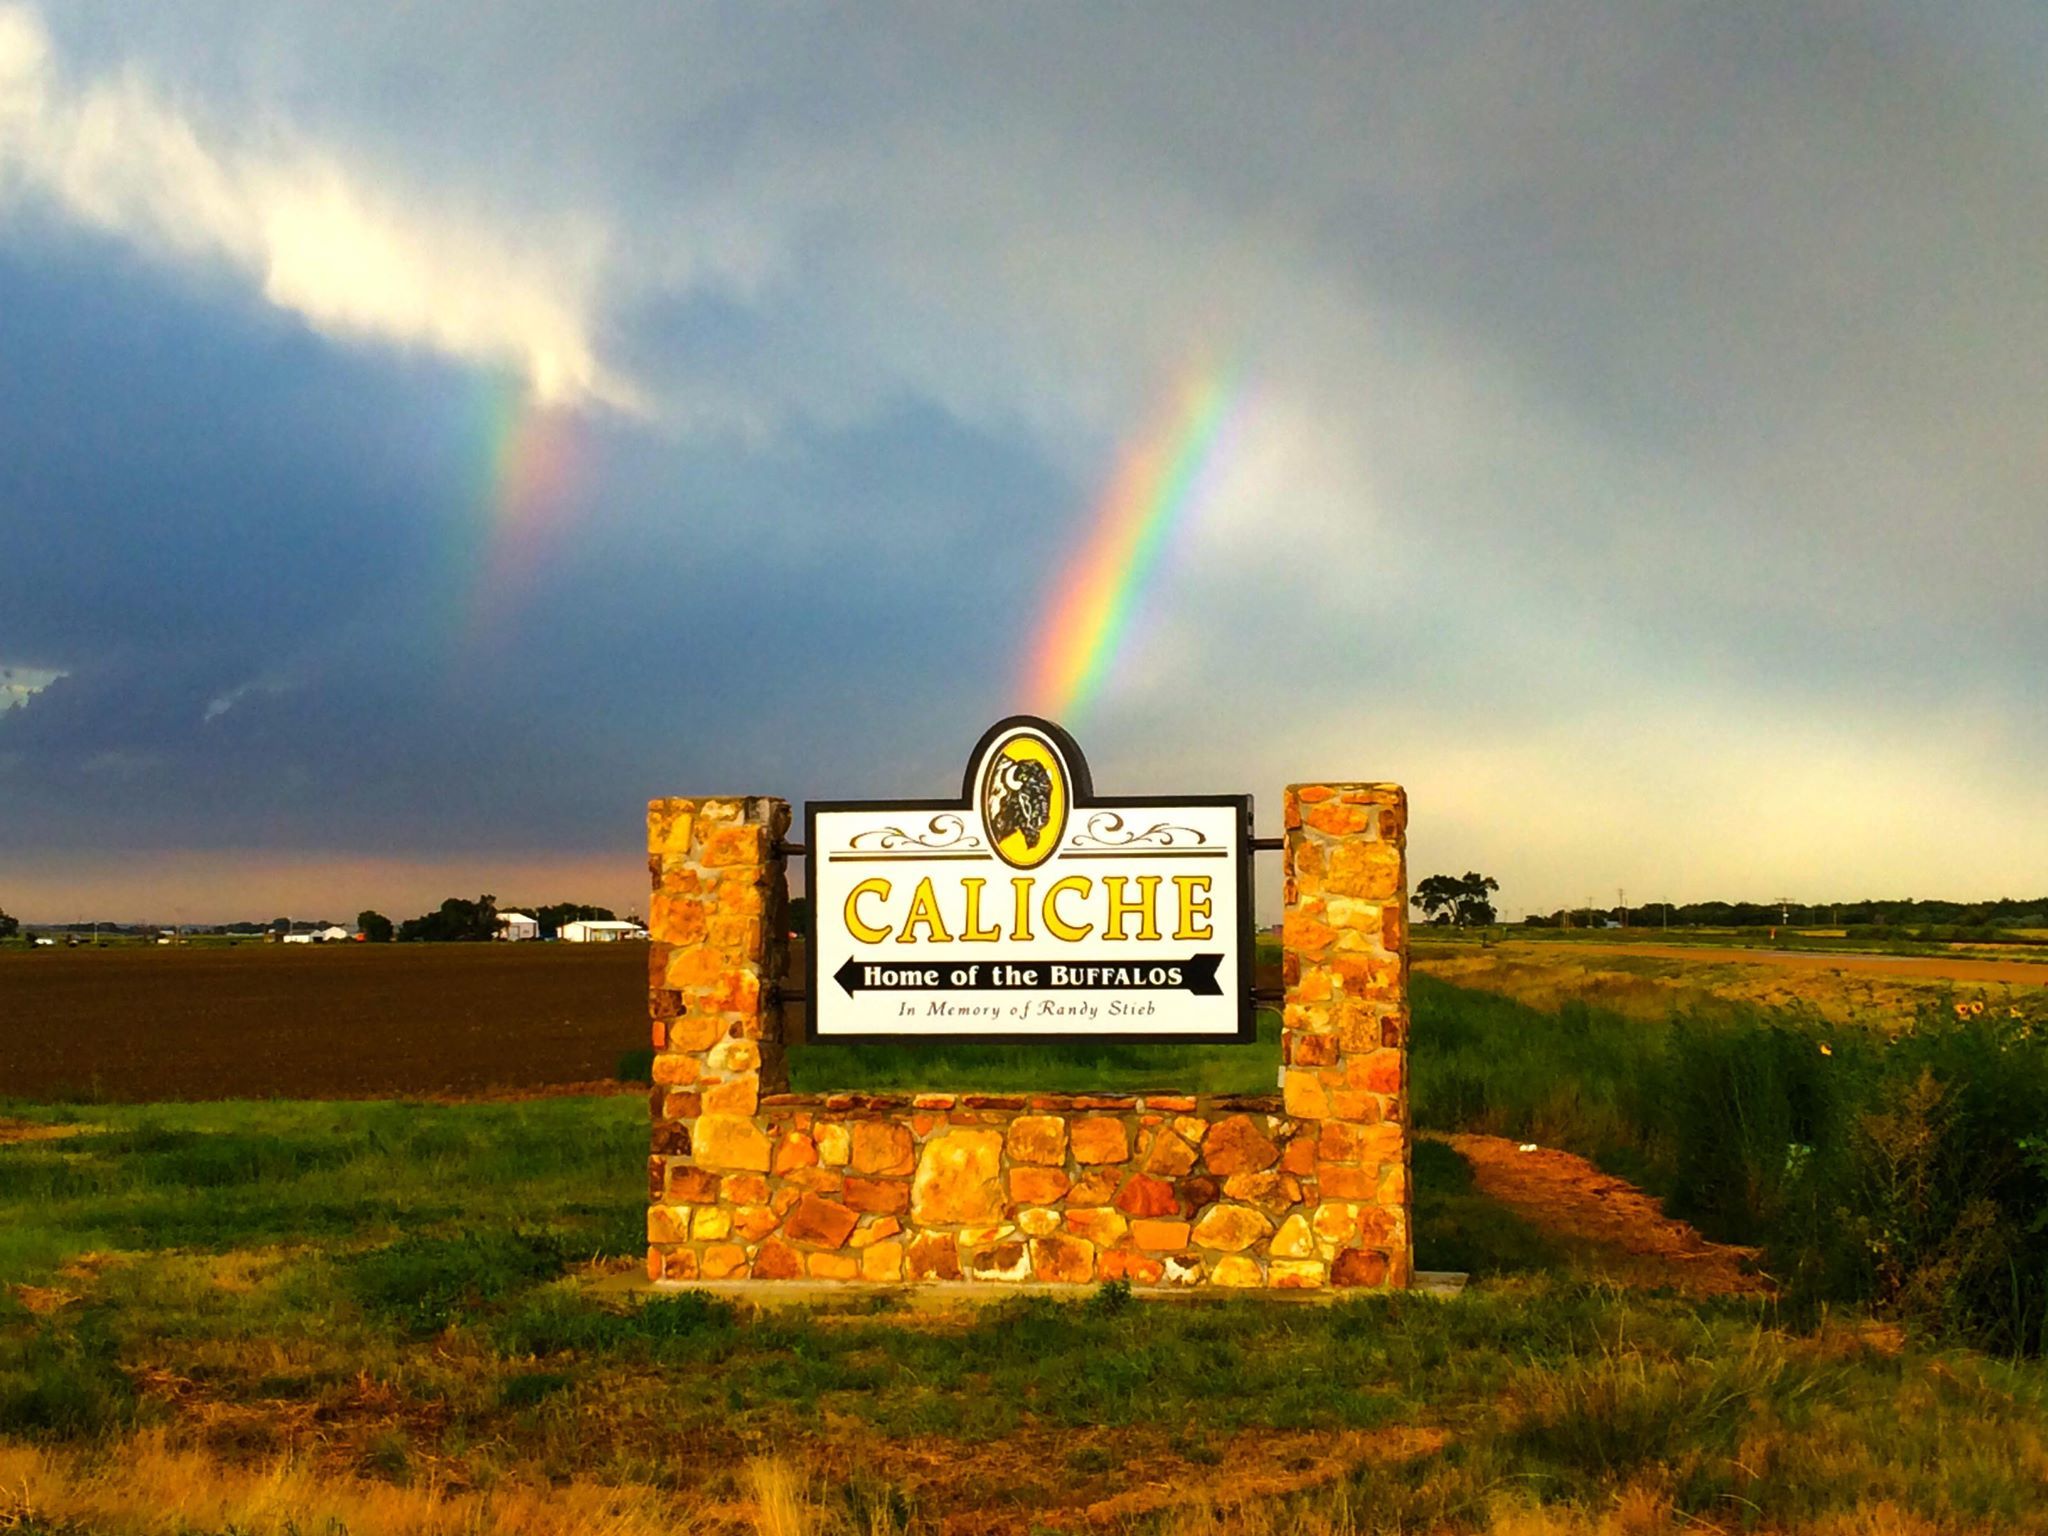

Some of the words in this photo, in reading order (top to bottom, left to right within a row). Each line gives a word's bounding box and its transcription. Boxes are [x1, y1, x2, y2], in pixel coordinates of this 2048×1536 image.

[843, 875, 1214, 945] CALICHE
[864, 965, 939, 987] Home
[950, 965, 979, 987] of
[992, 965, 1038, 987] the
[1050, 965, 1184, 987] BUFFALOS
[898, 1001, 916, 1017] In
[926, 1001, 1000, 1019] Memory
[1009, 1000, 1031, 1019] of
[1036, 1000, 1099, 1019] Randy
[1108, 1001, 1157, 1017] Stieb
